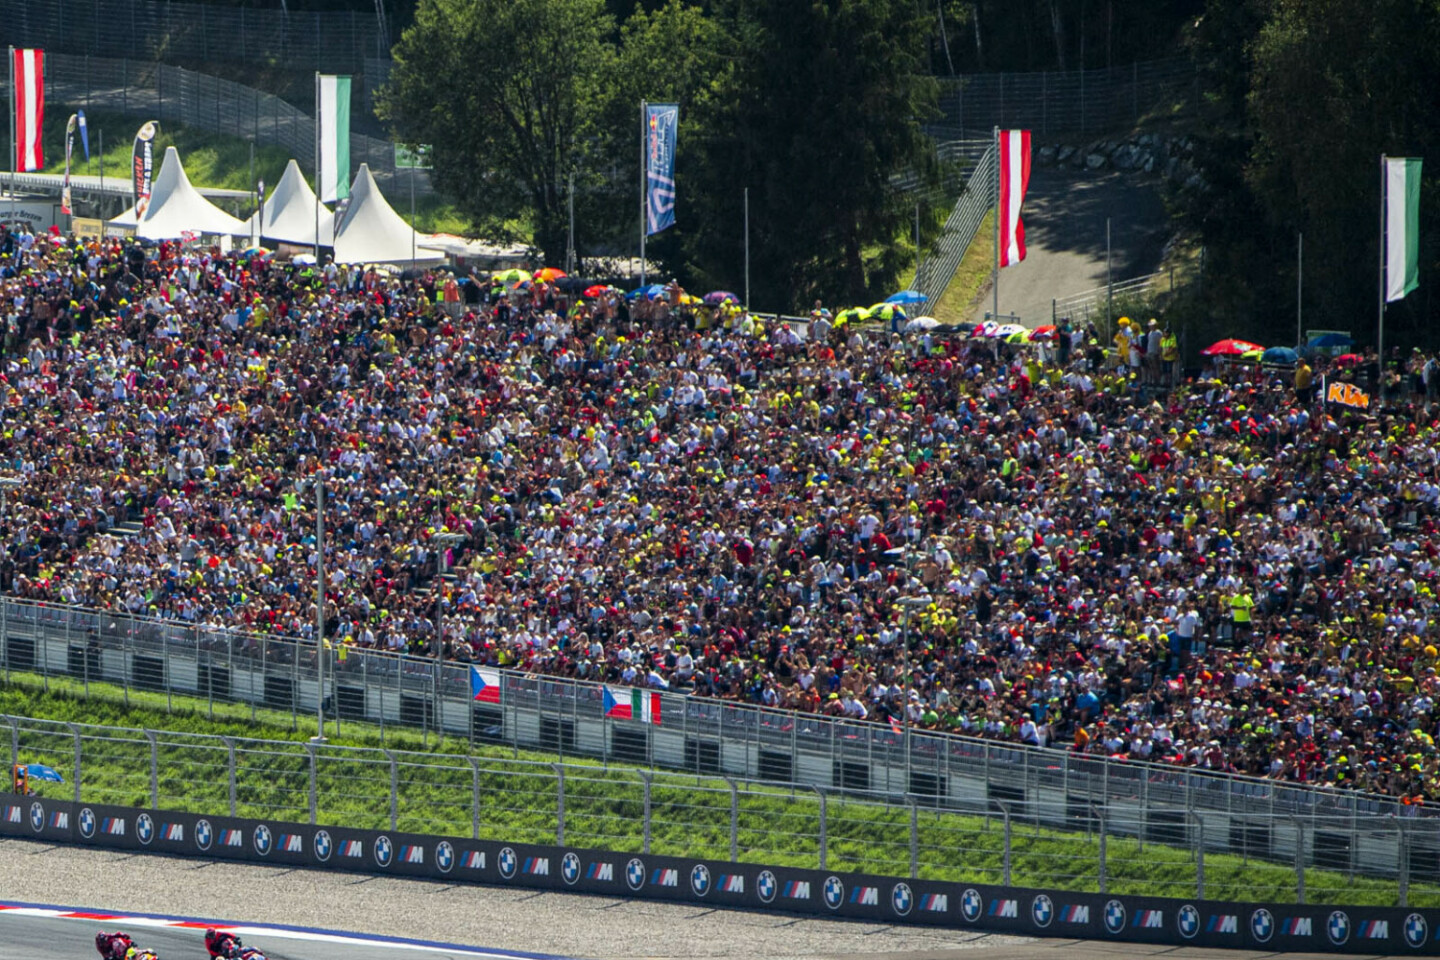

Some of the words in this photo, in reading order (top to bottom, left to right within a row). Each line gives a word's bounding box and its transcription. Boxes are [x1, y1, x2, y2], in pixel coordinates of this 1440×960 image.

[1327, 381, 1369, 409] KTM
[8, 806, 21, 823] M
[55, 812, 68, 829] M
[110, 818, 124, 835] M
[168, 824, 183, 841] M
[227, 830, 241, 847] M
[287, 835, 301, 852] M
[347, 841, 362, 858] M
[407, 846, 423, 864] M
[469, 852, 485, 869] M
[532, 858, 548, 875] M
[596, 863, 612, 881] M
[661, 869, 677, 887] M
[727, 875, 743, 892] M
[793, 882, 809, 899] M
[860, 887, 877, 904] M
[929, 894, 947, 911] M
[999, 900, 1017, 918] M
[1071, 905, 1088, 923] M
[1144, 910, 1162, 928] M
[1218, 915, 1237, 933] M
[1293, 918, 1312, 935] M
[1369, 921, 1388, 938] M
